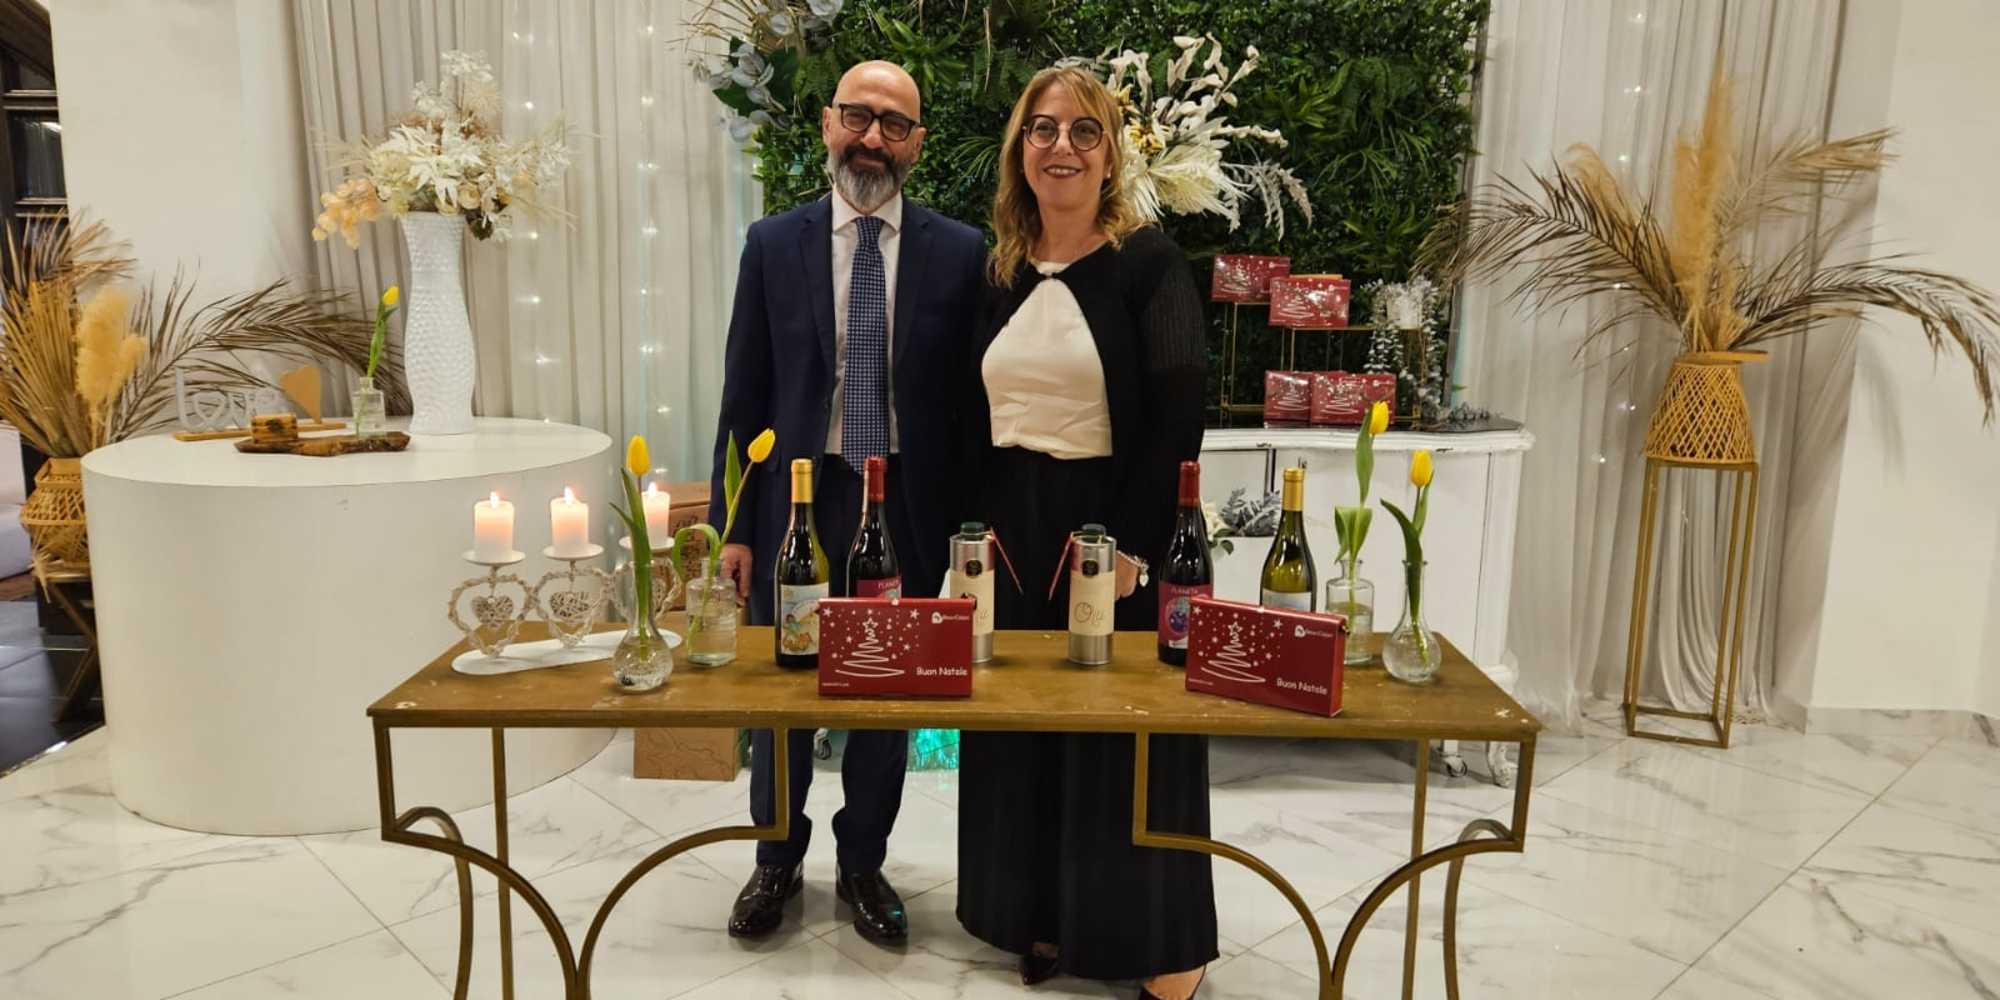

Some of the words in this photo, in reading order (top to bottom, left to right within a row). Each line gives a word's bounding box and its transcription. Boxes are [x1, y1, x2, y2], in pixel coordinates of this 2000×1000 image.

[916, 666, 937, 676] Buon
[938, 666, 968, 676] Natale
[1276, 677, 1297, 689] Buon
[1298, 681, 1328, 695] Natale
